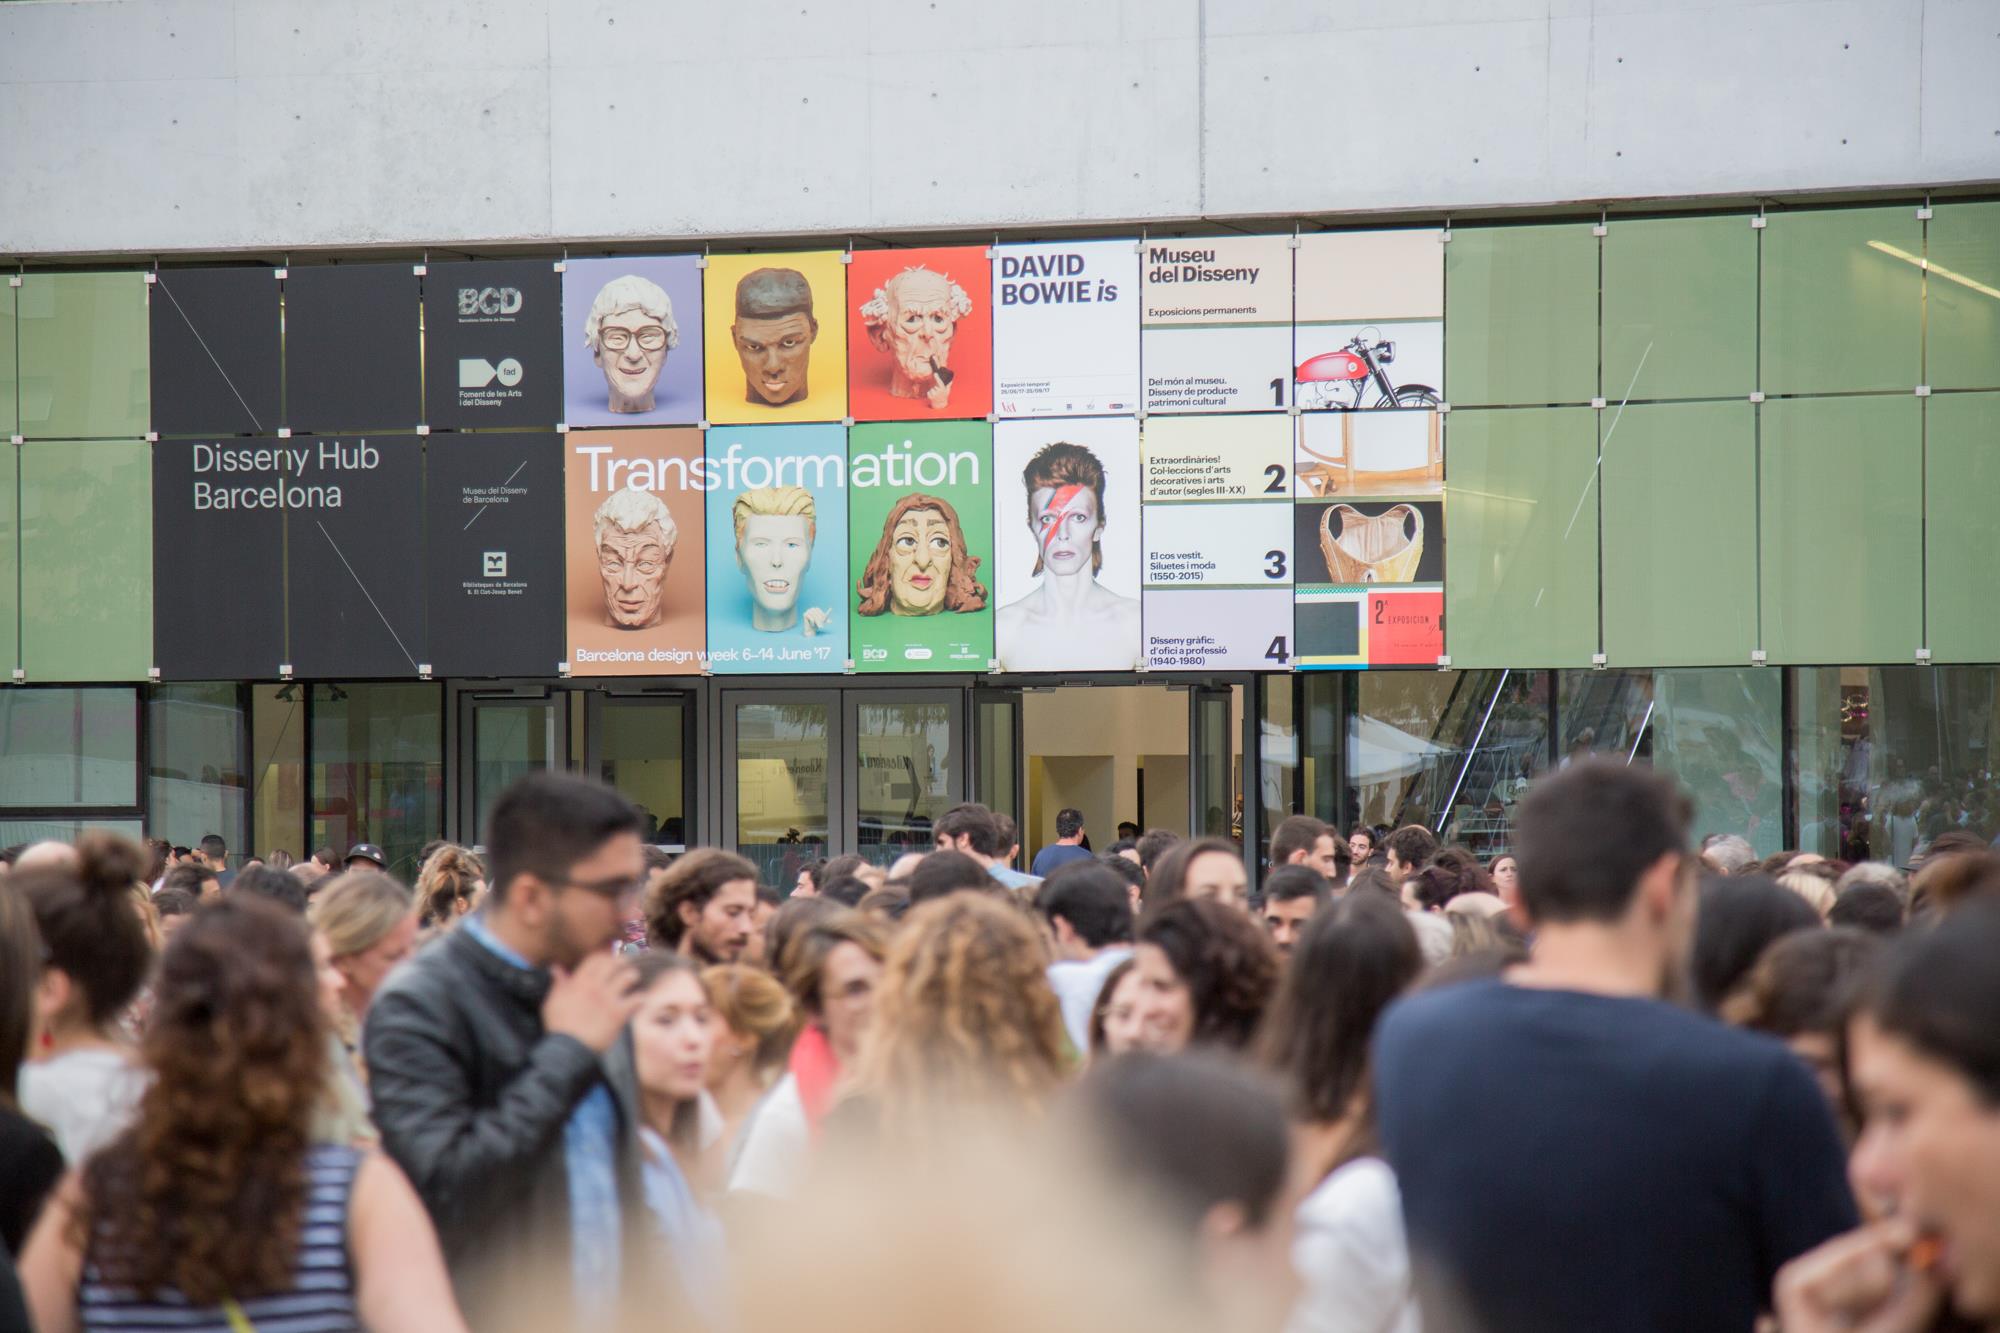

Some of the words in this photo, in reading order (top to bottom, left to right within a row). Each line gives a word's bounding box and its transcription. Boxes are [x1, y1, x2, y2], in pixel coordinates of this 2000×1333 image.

[1150, 247, 1215, 264] Museu
[1002, 254, 1085, 278] DAVID
[1149, 266, 1178, 283] del
[1183, 265, 1259, 284] Disseny
[1002, 281, 1091, 305] BOWIE
[1097, 279, 1118, 302] is
[459, 287, 522, 315] BCD
[1149, 307, 1201, 317] Exposicions
[1202, 306, 1257, 316] permanents
[503, 368, 516, 376] fad
[1149, 378, 1163, 386] Del
[1164, 378, 1184, 386] món
[1185, 377, 1194, 385] al
[1195, 377, 1227, 385] museu.
[1149, 388, 1182, 397] Disseny
[1184, 388, 1195, 396] de
[1196, 387, 1238, 396] producte
[1270, 378, 1284, 406] 1
[474, 399, 502, 407] Disseny
[1148, 398, 1191, 408] patrimoni
[1192, 397, 1226, 406] cultural
[193, 443, 309, 477] Disseny
[319, 439, 379, 470] Hub
[576, 440, 979, 492] Transformation
[1150, 477, 1202, 486] decoratives
[1264, 464, 1286, 493] 2
[194, 478, 342, 510] Barcelona
[463, 487, 487, 495] Museu
[488, 486, 499, 494] del
[500, 486, 527, 496] Disseny
[1183, 486, 1214, 496] (segles
[1216, 485, 1246, 495] III-XX)
[1150, 552, 1159, 560] El
[1160, 552, 1175, 560] cos
[1176, 551, 1203, 560] vestit.
[1150, 562, 1185, 570] Siluetes
[1190, 561, 1216, 569] moda
[1264, 550, 1286, 579] 3
[1150, 572, 1203, 581] (1550-2015)
[1150, 636, 1184, 645] Disseny
[576, 648, 644, 662] Barcelona
[648, 647, 693, 664] design
[697, 646, 739, 661] week
[777, 647, 812, 661] June
[1185, 646, 1227, 656] professió
[1265, 636, 1289, 664] 4
[1150, 656, 1205, 666] (1940-1980)
